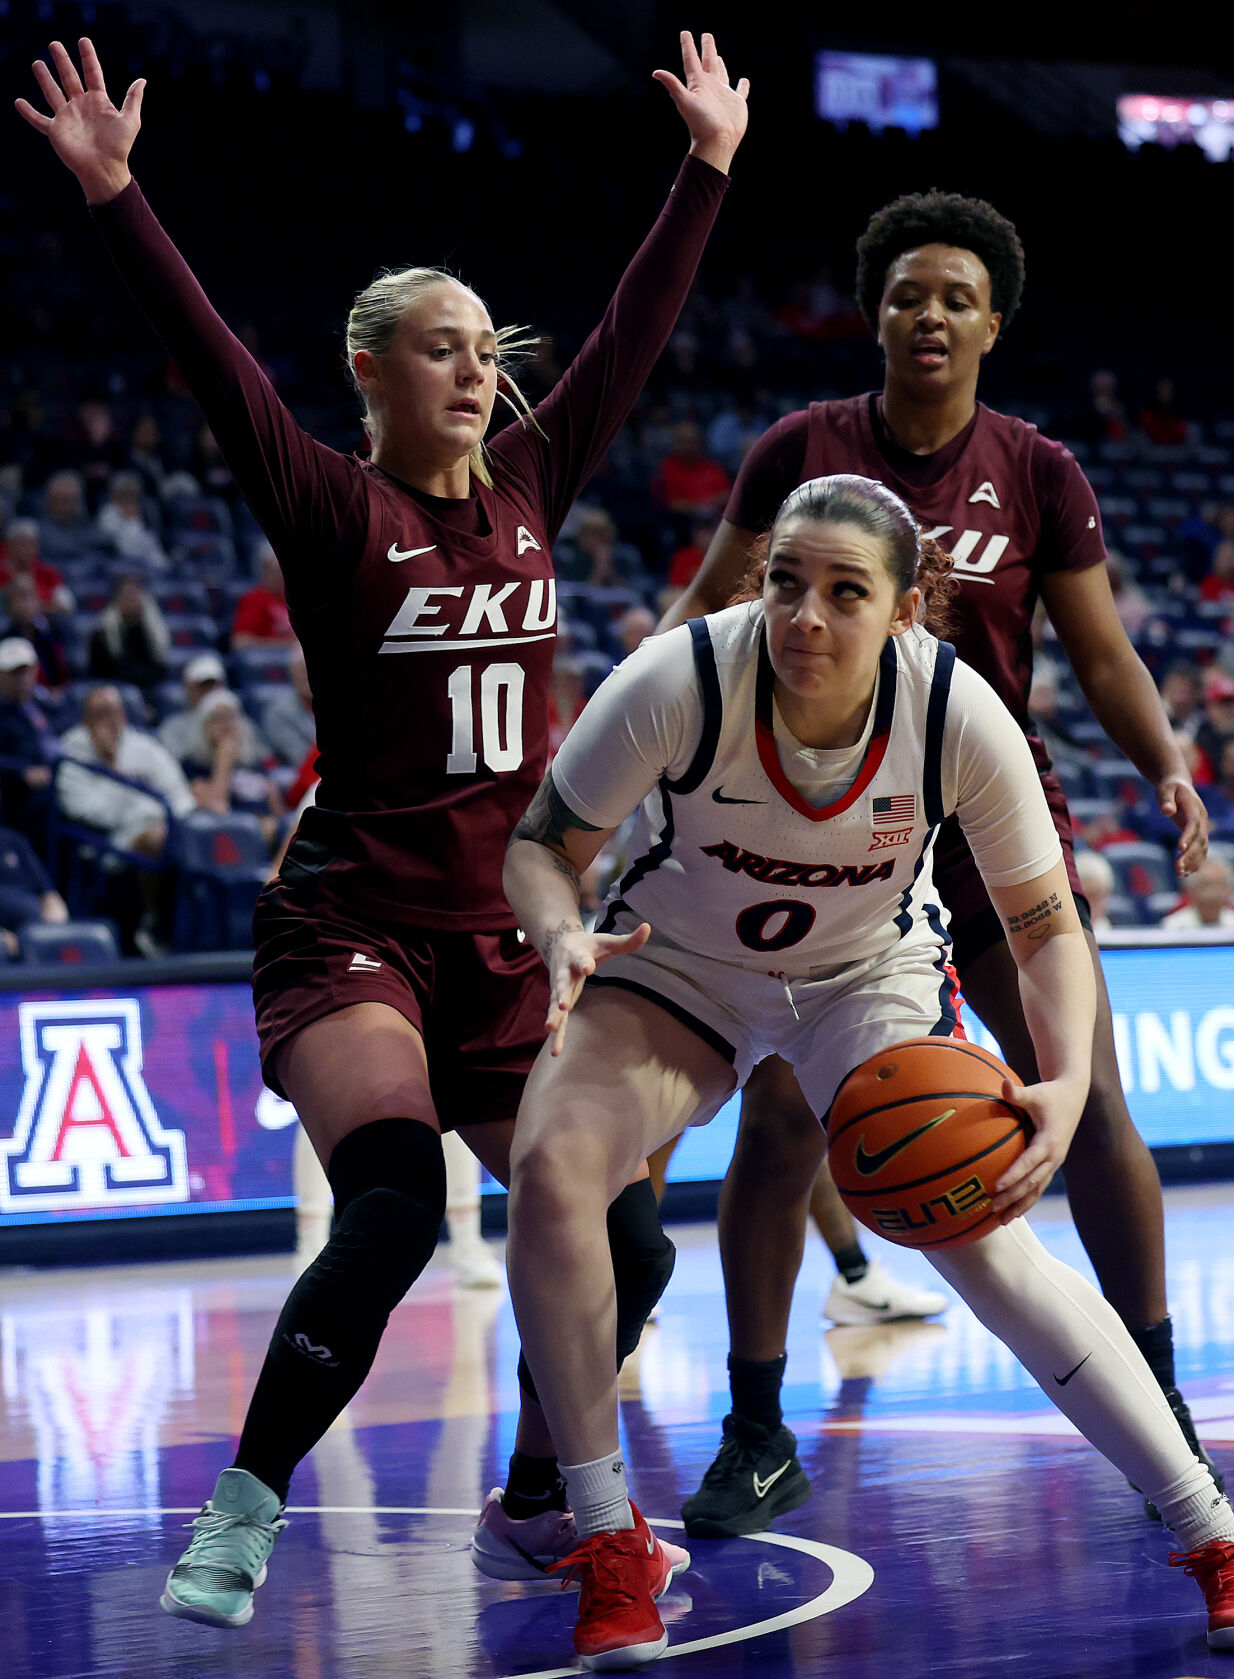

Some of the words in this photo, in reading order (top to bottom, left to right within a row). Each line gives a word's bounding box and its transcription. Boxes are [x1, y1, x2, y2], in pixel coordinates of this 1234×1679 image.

[384, 577, 557, 637] EKU
[446, 662, 526, 775] 10
[698, 839, 897, 887] ARIZONA
[735, 899, 817, 952] 0
[872, 1175, 988, 1232] ELITE
